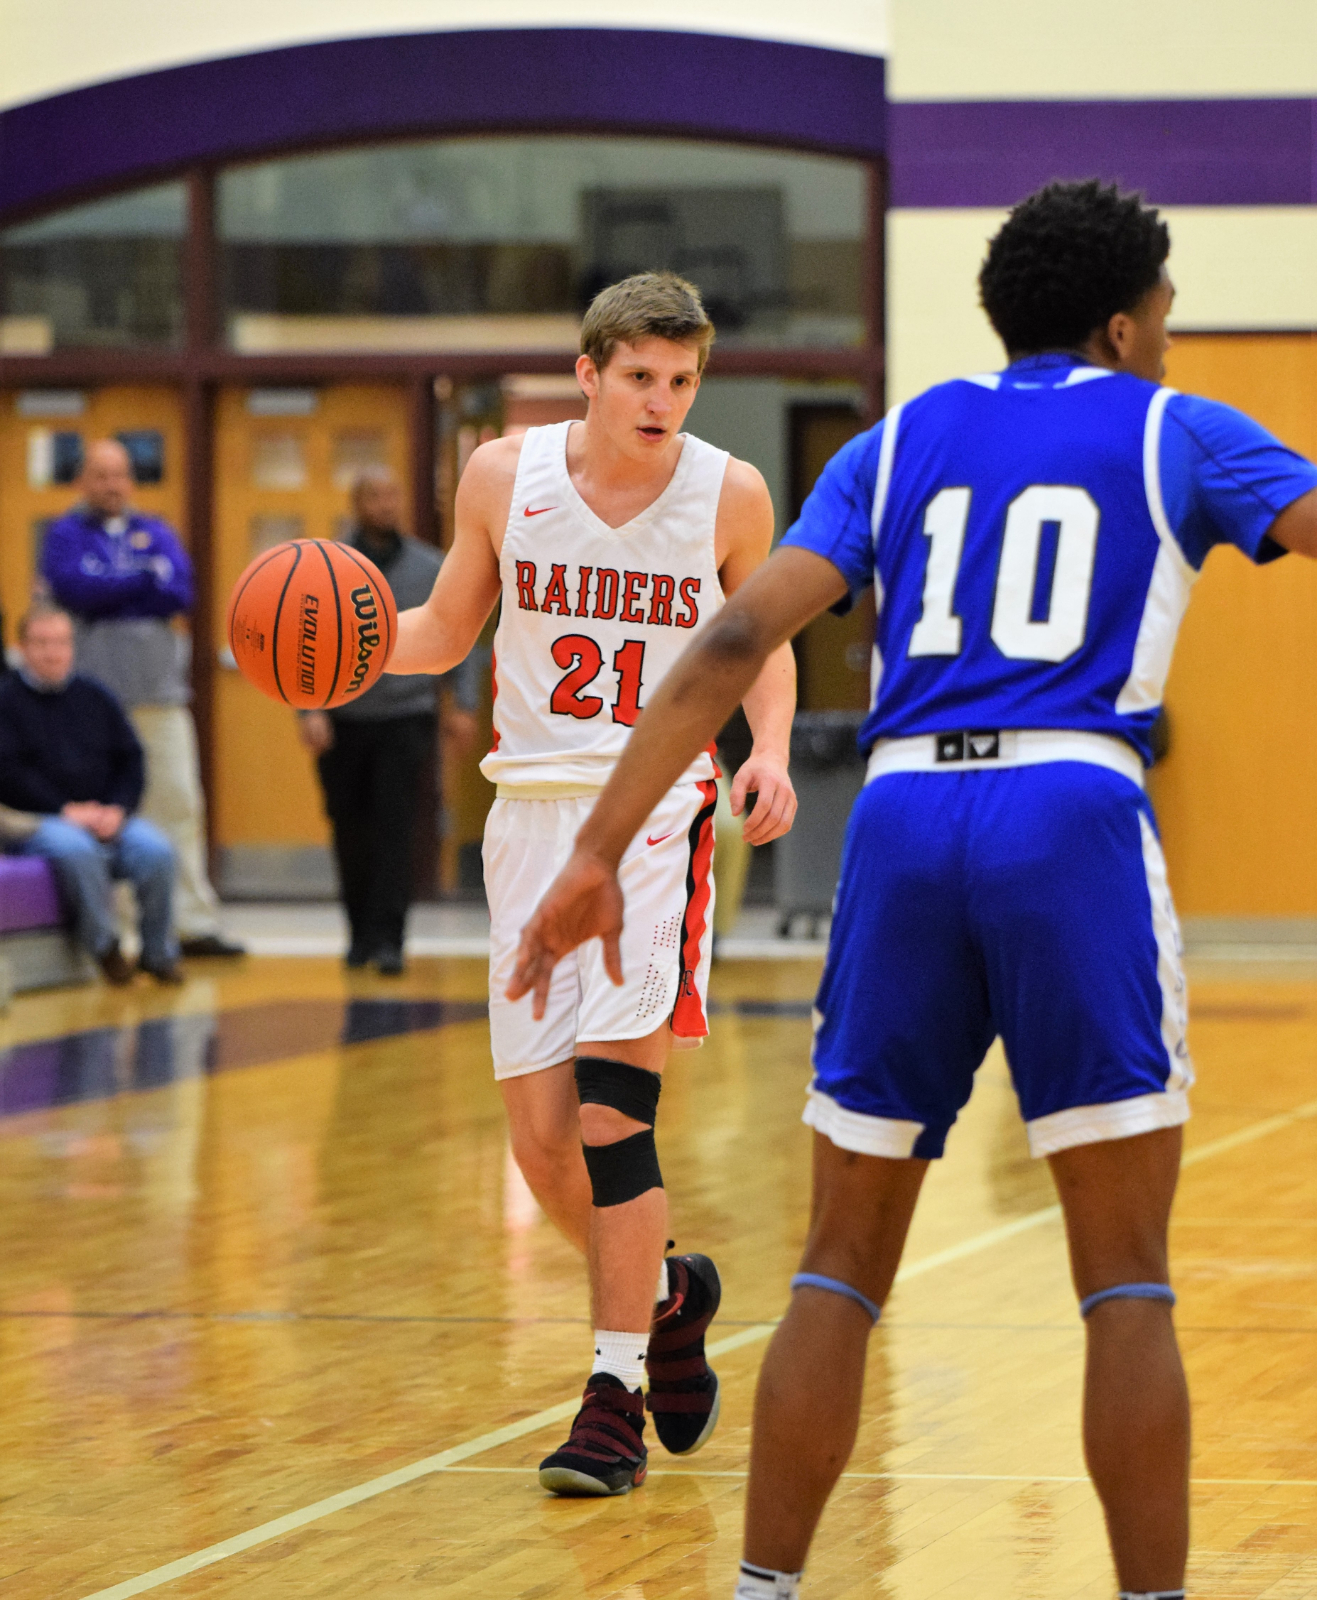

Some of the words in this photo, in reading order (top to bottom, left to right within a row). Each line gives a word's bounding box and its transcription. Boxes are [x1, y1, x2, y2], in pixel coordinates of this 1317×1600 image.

[515, 559, 701, 628] RAIDERS
[907, 483, 1100, 663] 10
[301, 594, 319, 695] EVOLUTION
[345, 583, 380, 693] Wilson
[550, 633, 646, 727] 21
